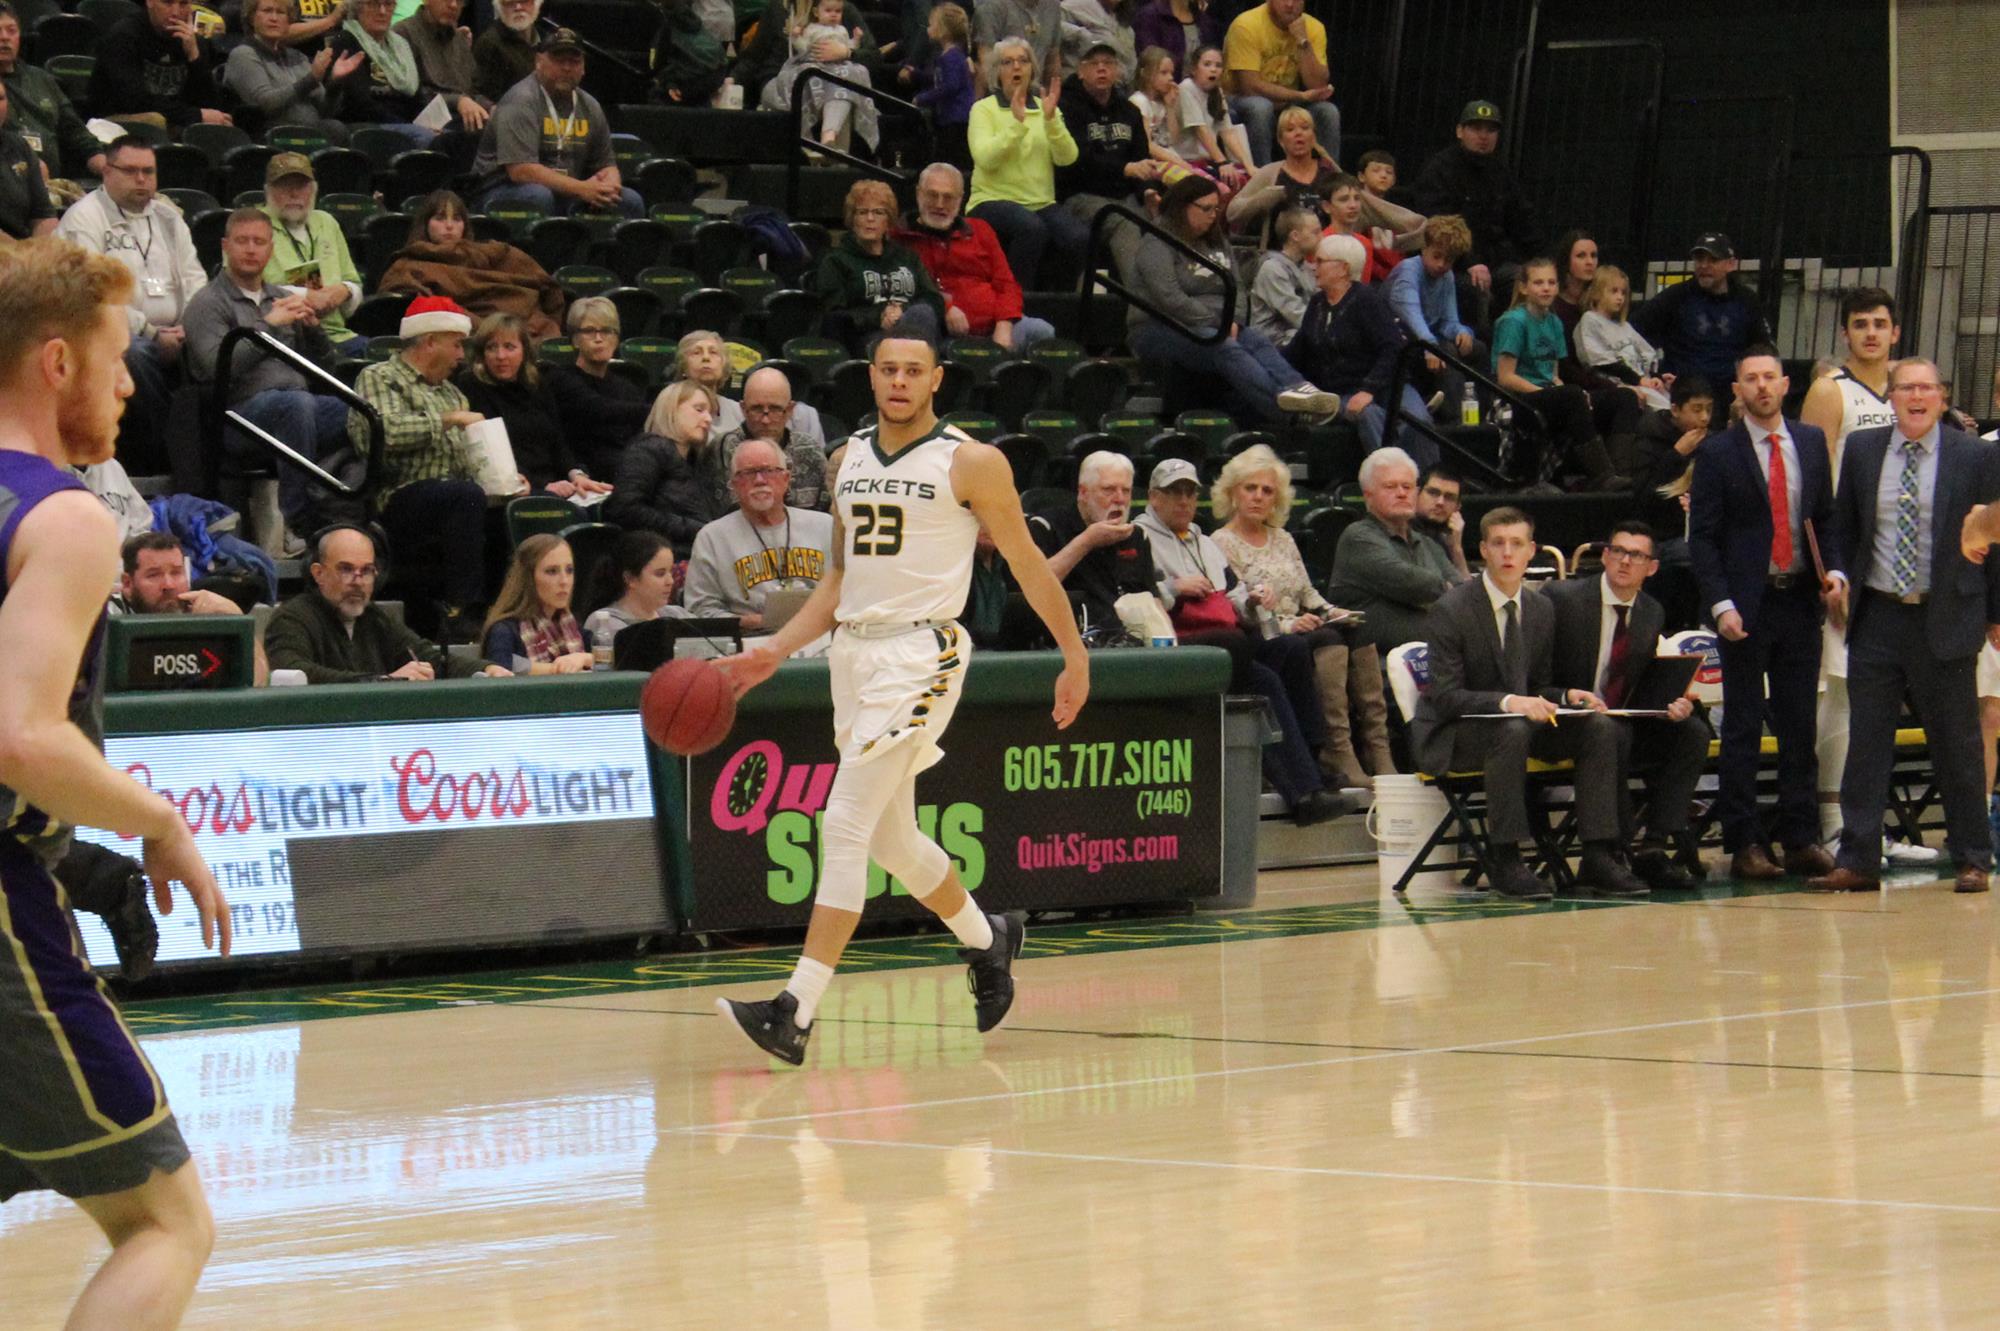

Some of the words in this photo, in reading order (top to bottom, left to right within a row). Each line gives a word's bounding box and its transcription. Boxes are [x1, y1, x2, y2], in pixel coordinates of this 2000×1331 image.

[1856, 413, 1900, 426] JACKE
[850, 503, 905, 556] 23
[154, 654, 201, 675] POSS.
[1004, 738, 1192, 792] 605.717.SIGN
[258, 783, 367, 831] LIGHT
[391, 748, 532, 823] Coors
[531, 769, 634, 815] LIGHT
[711, 740, 836, 835] Qu
[1137, 788, 1192, 820] (7446)
[1017, 832, 1179, 873] QuikSigns.com
[223, 861, 265, 888] THE
